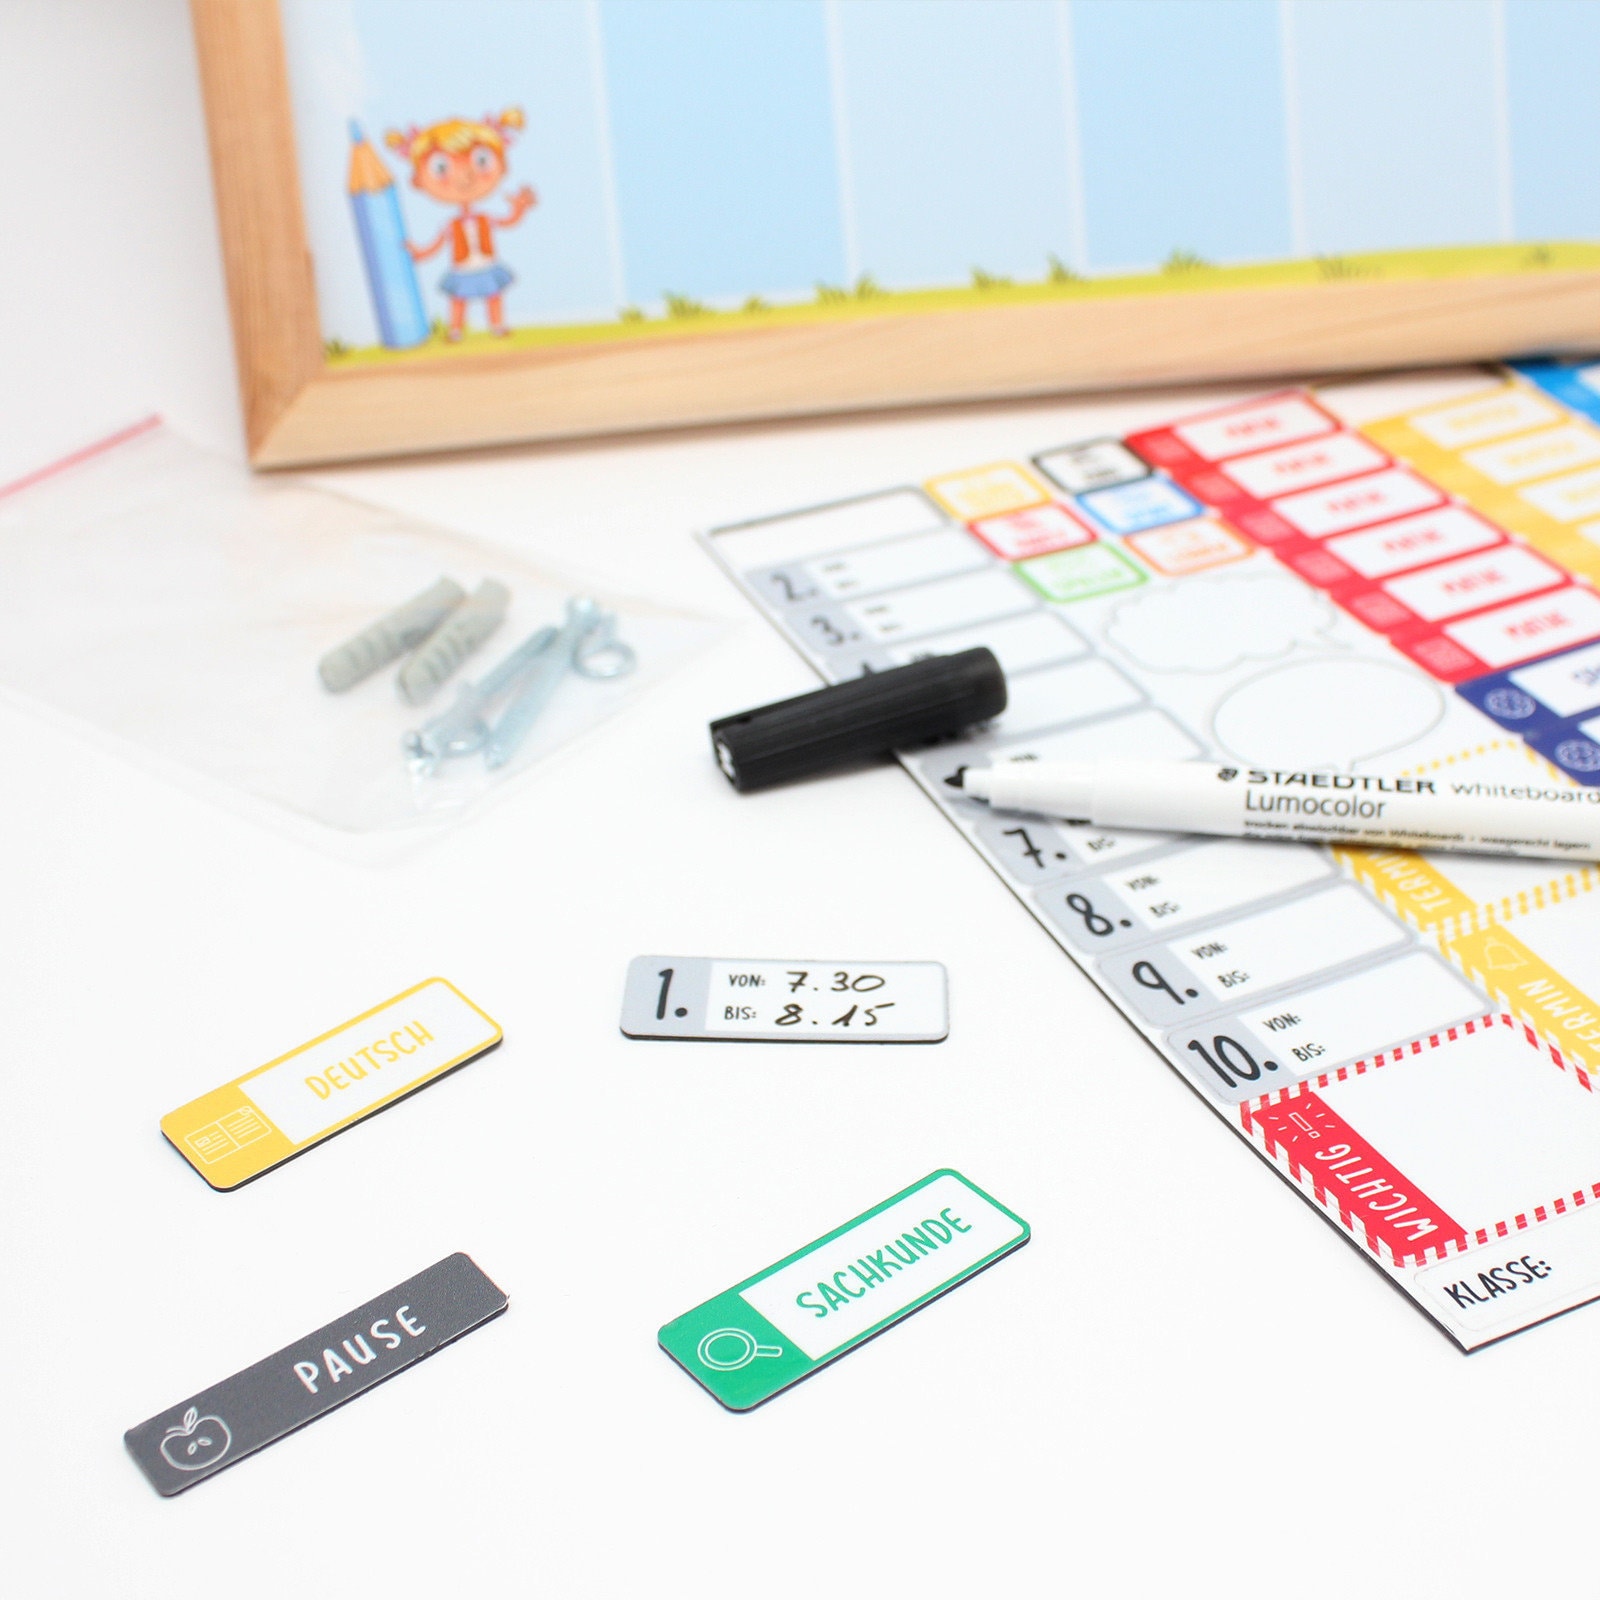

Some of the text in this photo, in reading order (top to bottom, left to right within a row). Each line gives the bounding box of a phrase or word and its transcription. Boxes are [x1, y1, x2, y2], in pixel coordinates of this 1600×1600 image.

[1245, 789, 1387, 819] Lumocolor
[1247, 769, 1436, 795] STAEDTLER
[1003, 828, 1067, 869] 7.
[1366, 851, 1452, 913] TERMI
[1066, 893, 1133, 937] 8.
[656, 968, 688, 1021] 1.
[728, 974, 766, 988] VON:
[786, 971, 886, 993] 7.30
[1132, 961, 1199, 1005] 9.
[723, 1005, 757, 1021] BIS:
[774, 1002, 896, 1027] 8.15
[1262, 1012, 1302, 1033] VON:
[304, 1020, 435, 1101] DEUTSCH
[1187, 1035, 1279, 1089] 10.
[1291, 1042, 1326, 1063] BIS:
[1314, 1143, 1439, 1242] WICHTIG
[795, 1206, 973, 1319] SACHKUNDE
[1442, 1255, 1553, 1309] KLASSE:
[292, 1304, 427, 1395] PAUSE
